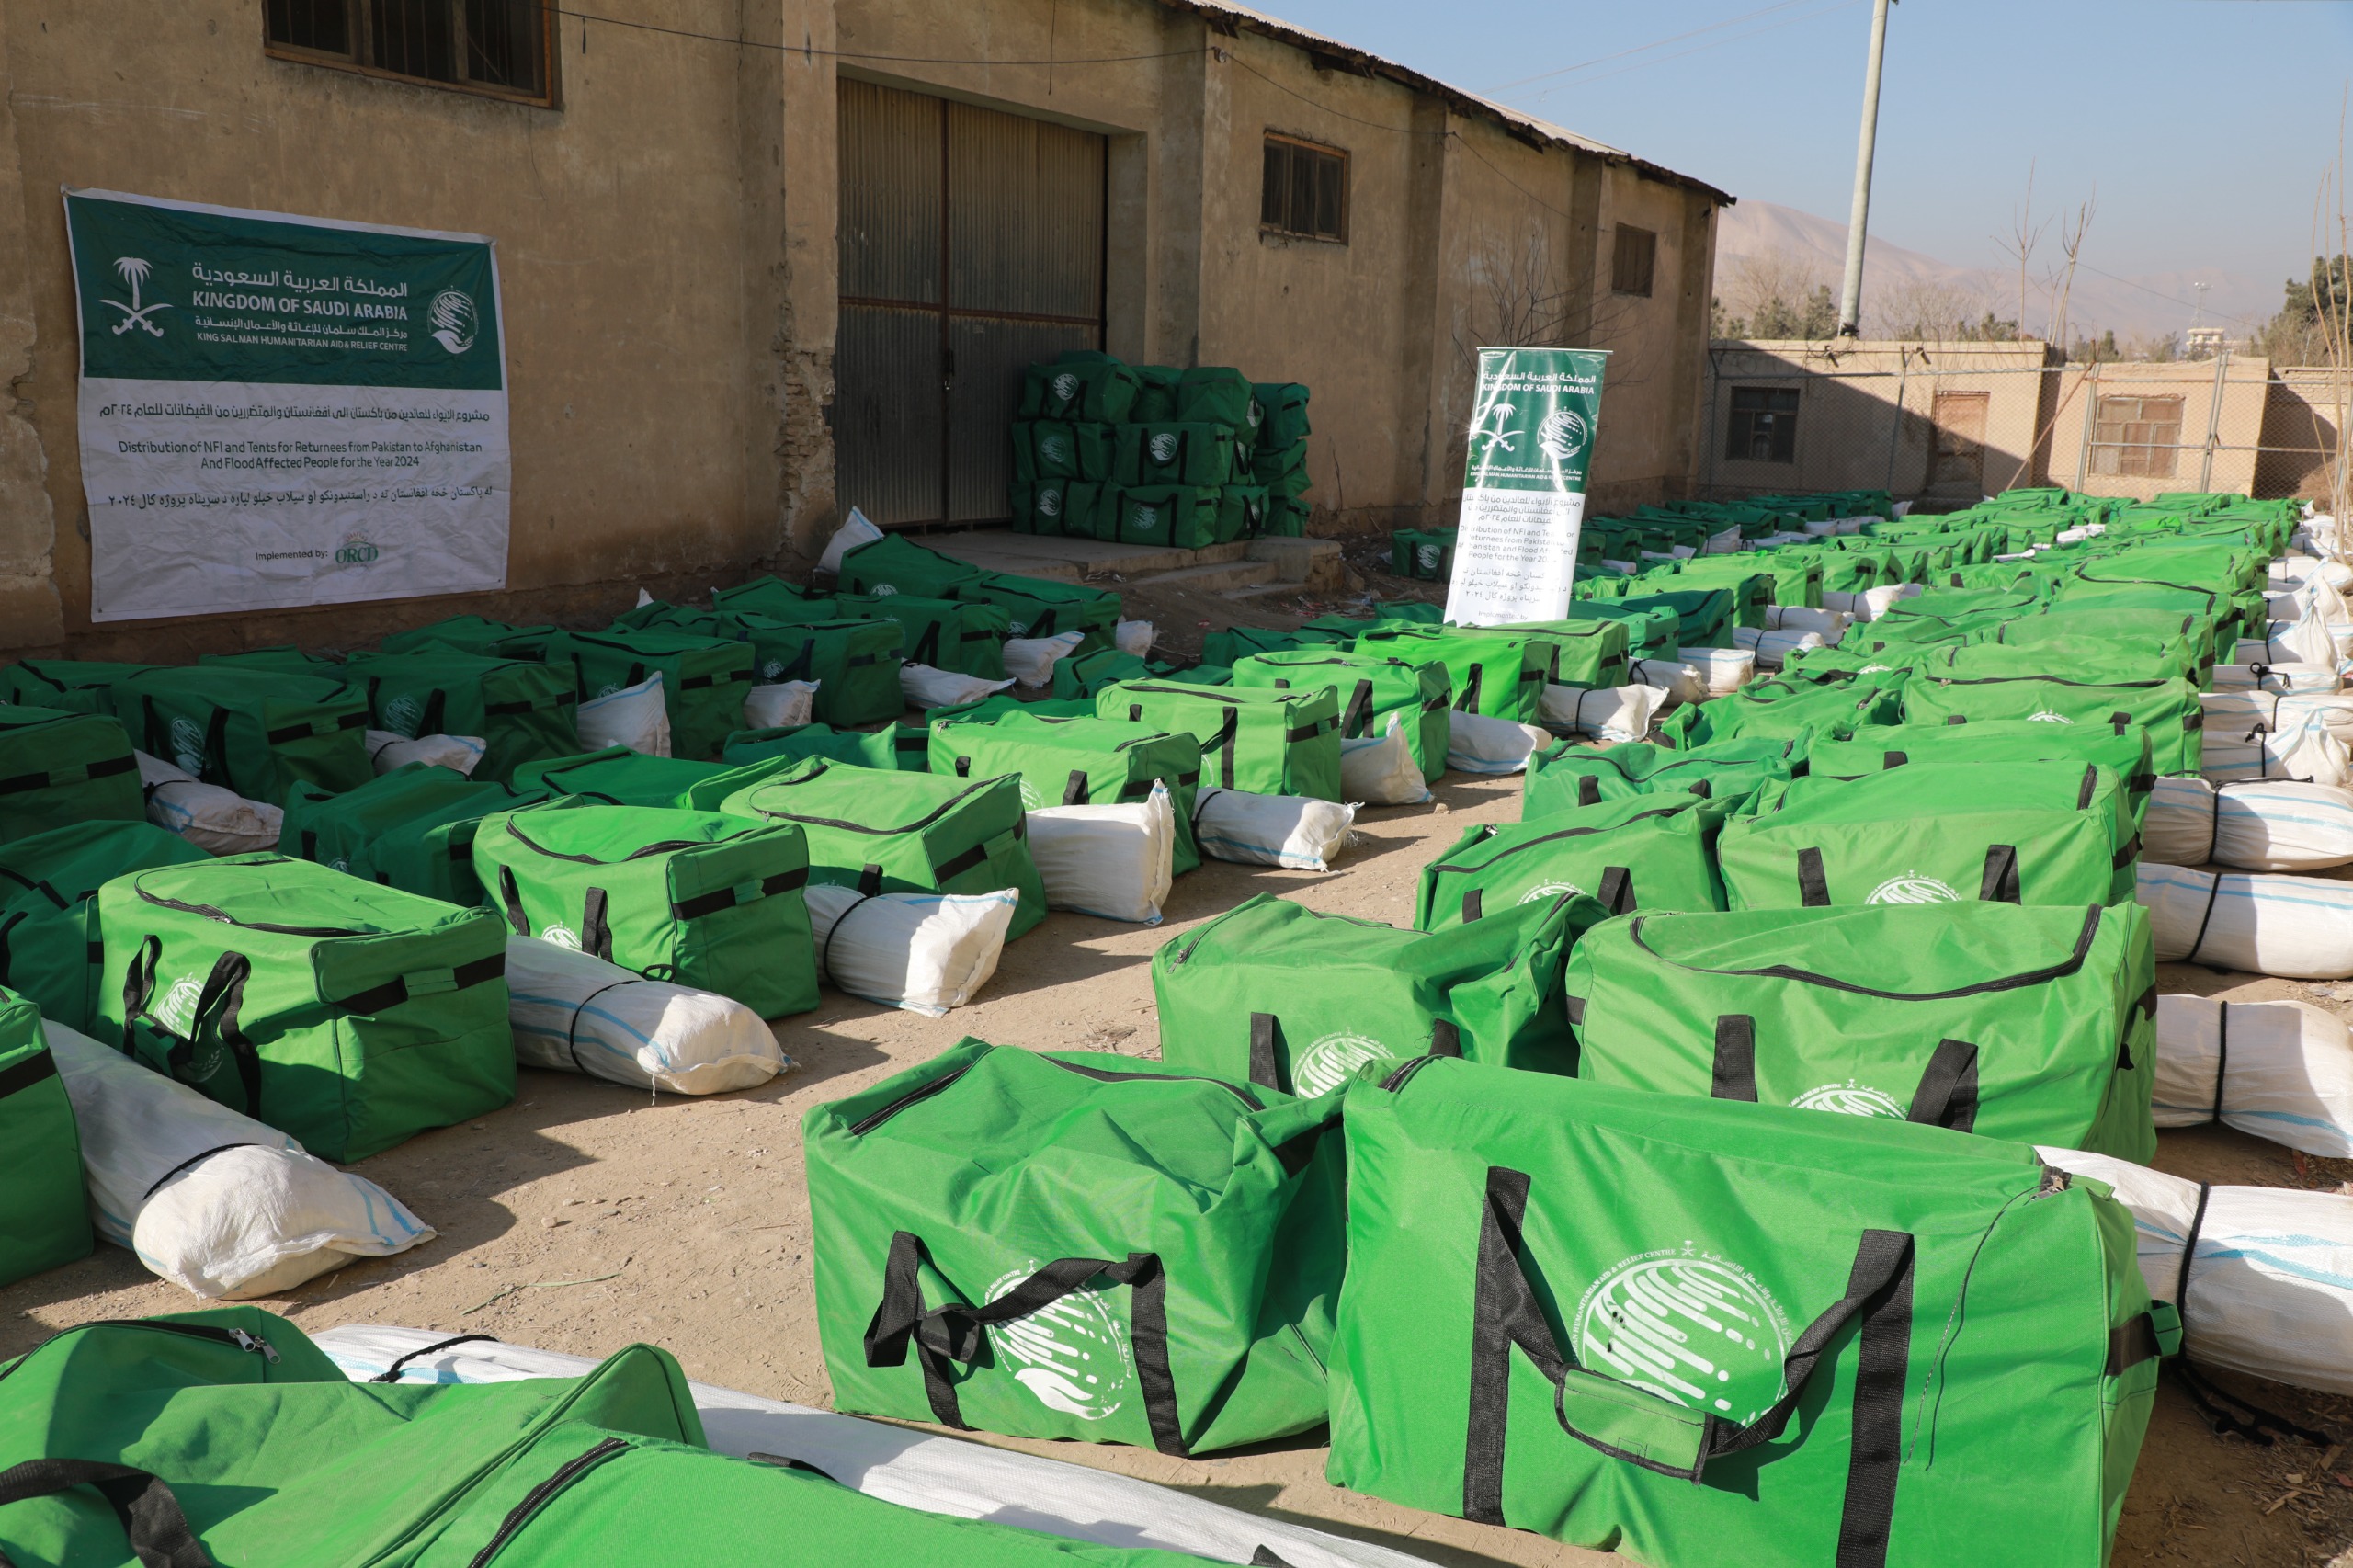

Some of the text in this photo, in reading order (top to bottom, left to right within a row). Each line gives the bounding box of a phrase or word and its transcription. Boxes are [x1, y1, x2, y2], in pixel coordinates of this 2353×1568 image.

[192, 262, 408, 298] المملكة العربية السعودية
[193, 291, 408, 321] KINGDOM OF SAUDI ARABIA
[195, 315, 408, 339] مركز الملك سلمان للإغاثة والأعمال الإنسانية
[197, 332, 219, 342] KING
[221, 334, 258, 344] SALMAN
[261, 336, 329, 347] HUMANITARIAN
[330, 340, 344, 348] AID
[351, 340, 378, 349] RELIEF
[379, 342, 408, 351] CENTRE
[1528, 371, 1558, 382] العربية
[1559, 371, 1597, 383] المملكة
[1522, 383, 1535, 392] OF
[1535, 384, 1562, 392] SAUDI
[1562, 385, 1595, 394] ARABIA
[133, 403, 163, 418] للعام
[165, 403, 213, 419] الفيضانات
[214, 406, 230, 418] من
[232, 404, 281, 420] والمتضررين
[350, 407, 383, 421] باكستان
[384, 409, 398, 420] من
[432, 408, 455, 423] الإيواء
[455, 409, 490, 423] مشروع
[119, 441, 483, 455] Distribution of NFI and Tents for Returnees from Pakistan to Afghanistan
[201, 456, 420, 469] And Flood Affected People for the Year 2024
[483, 485, 493, 495] له
[335, 547, 379, 564] ORCD
[1502, 544, 1517, 552] and
[1517, 545, 1539, 553] Flood
[256, 550, 328, 562] Implemented by:
[1468, 551, 1493, 561] People
[1617, 1253, 1644, 1269] RELIEF
[1643, 1248, 1677, 1259] CENTRE
